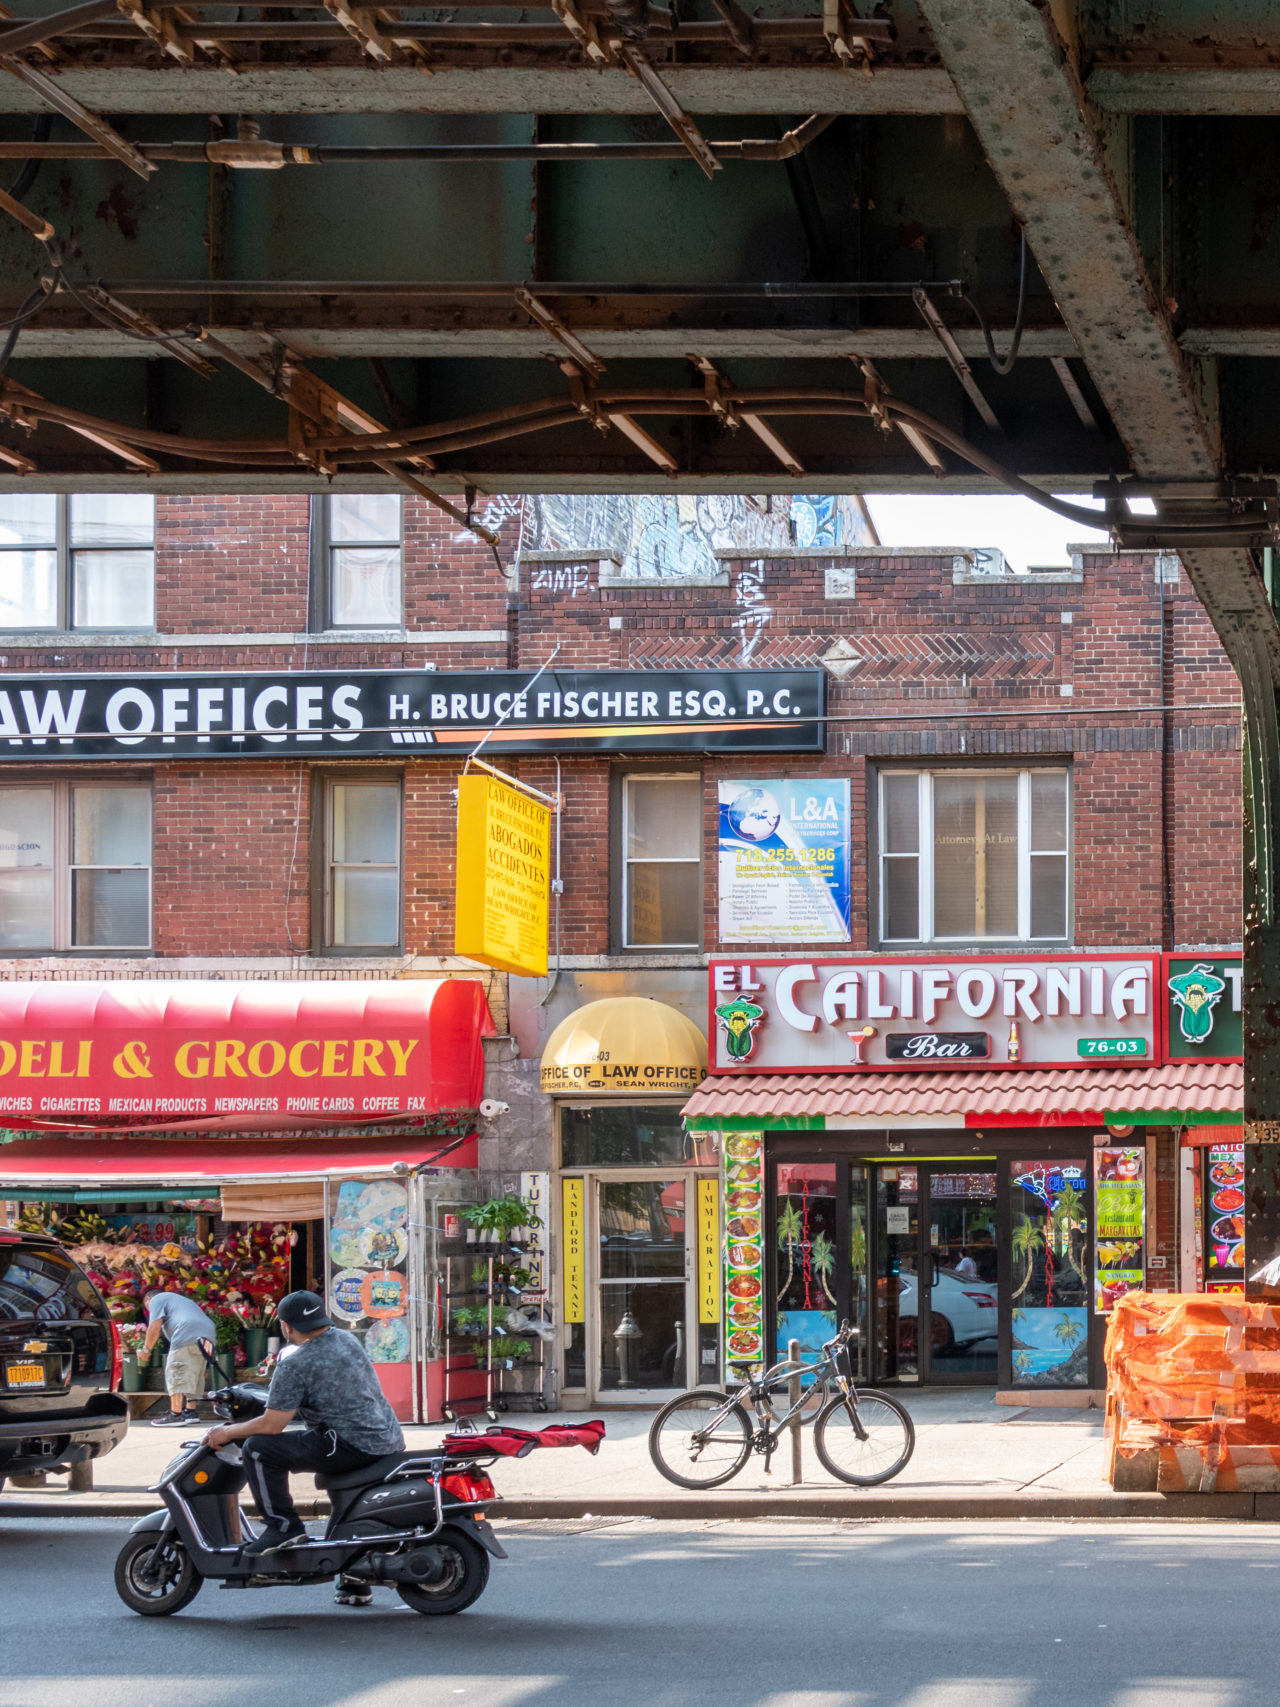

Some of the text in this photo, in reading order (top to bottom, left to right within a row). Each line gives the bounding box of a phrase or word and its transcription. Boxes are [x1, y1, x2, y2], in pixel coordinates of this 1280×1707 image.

[105, 684, 364, 745] OFFICES
[389, 695, 420, 720] H.
[431, 693, 527, 720] BRUCE
[538, 691, 659, 718] FISCHER
[668, 690, 736, 718] ESQ.
[746, 689, 801, 716] P.C.
[489, 783, 546, 825] LAW OFFICE OF
[790, 797, 838, 821] L&A
[490, 824, 543, 861] ABOGADOS
[935, 833, 1018, 845] Attorney At Law
[488, 848, 545, 885] ACCIDENTES
[735, 848, 836, 862] 718.255.1286
[714, 963, 1149, 1032] EL CALIFORNIA
[902, 1033, 972, 1057] Bar
[1087, 1041, 1139, 1054] 76-03
[113, 1041, 154, 1078] &
[174, 1039, 419, 1078] GROCERY
[573, 1066, 592, 1078] OF
[602, 1066, 639, 1078] LAW
[643, 1066, 697, 1080] OFFICE
[648, 1081, 691, 1089] WRIGHT,
[40, 1097, 101, 1111] CIGARETTES
[109, 1098, 152, 1111] MEXICAN
[155, 1098, 207, 1111] PRODUCTS
[214, 1097, 278, 1111] NEWSPAPERS
[287, 1097, 320, 1111] PHONE
[322, 1097, 355, 1111] CARDS
[362, 1096, 399, 1110] COFFEE
[407, 1096, 426, 1110] FAX
[1098, 1194, 1137, 1213] Bar
[528, 1174, 541, 1288] TUTORING
[781, 1169, 812, 1310] EL CALIFORNIA
[1099, 1224, 1140, 1237] MARGARITAS
[569, 1183, 579, 1319] LANDLORD TENANT
[705, 1182, 714, 1319] IMMIGRATION
[1106, 1272, 1135, 1280] SANGRIA
